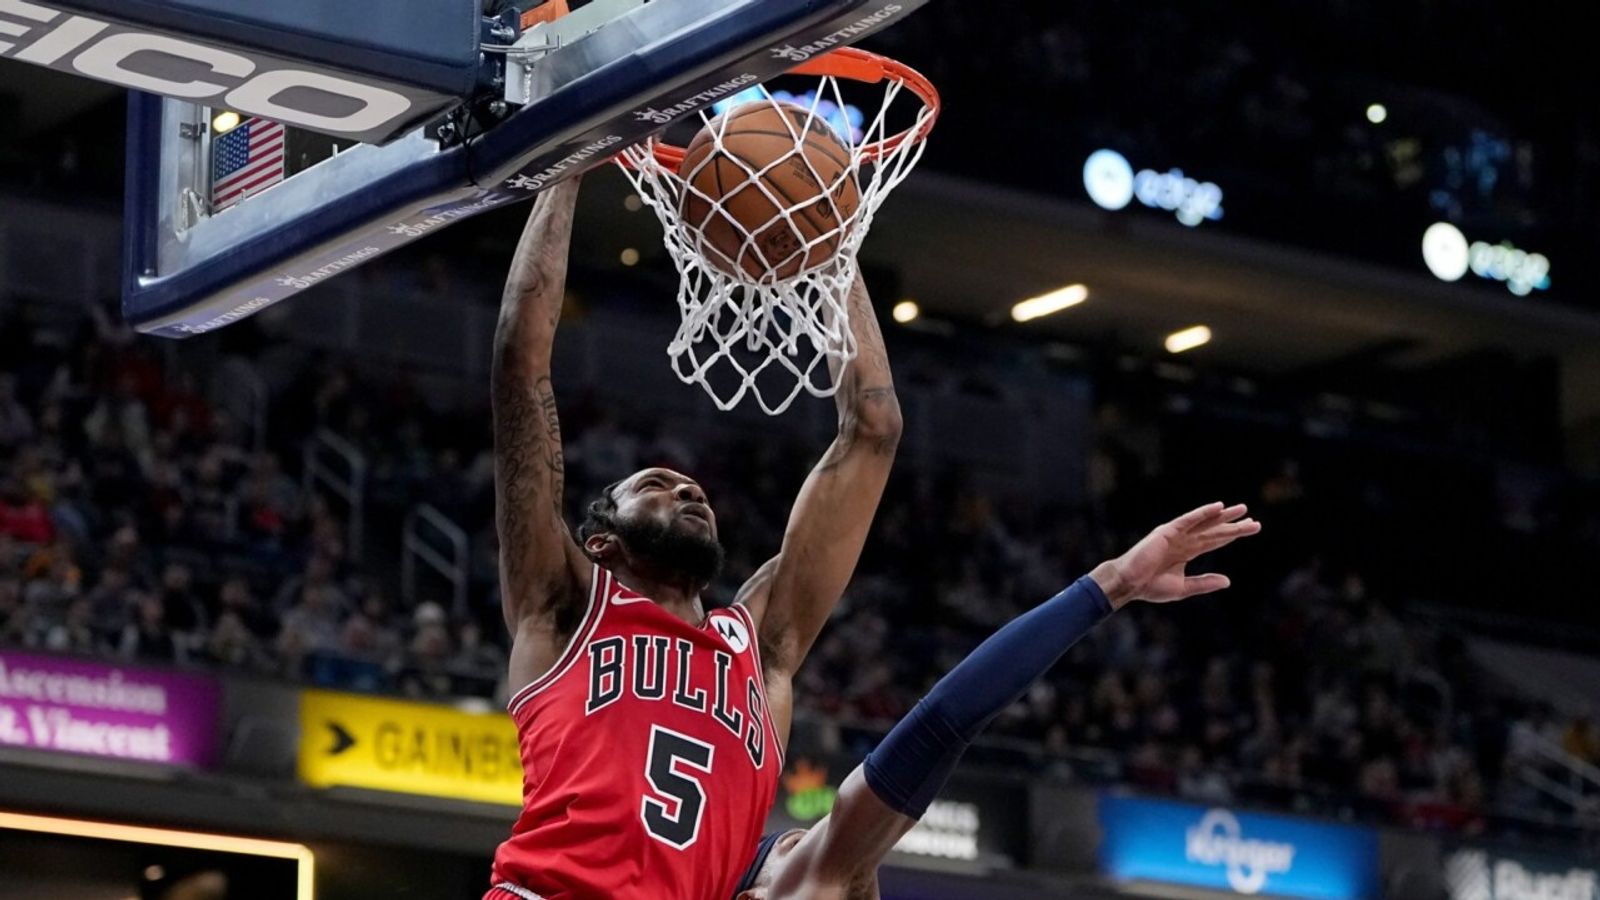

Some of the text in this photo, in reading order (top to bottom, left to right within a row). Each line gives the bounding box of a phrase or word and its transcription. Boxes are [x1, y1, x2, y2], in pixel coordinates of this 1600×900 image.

[790, 2, 903, 61] DRAFTKINGS
[653, 72, 758, 124] DRAFTKINGS
[524, 134, 622, 190] DRAFTKINGS
[294, 246, 380, 289] DRAFTKINGS
[585, 634, 766, 770] BULLS
[640, 723, 716, 851] 5
